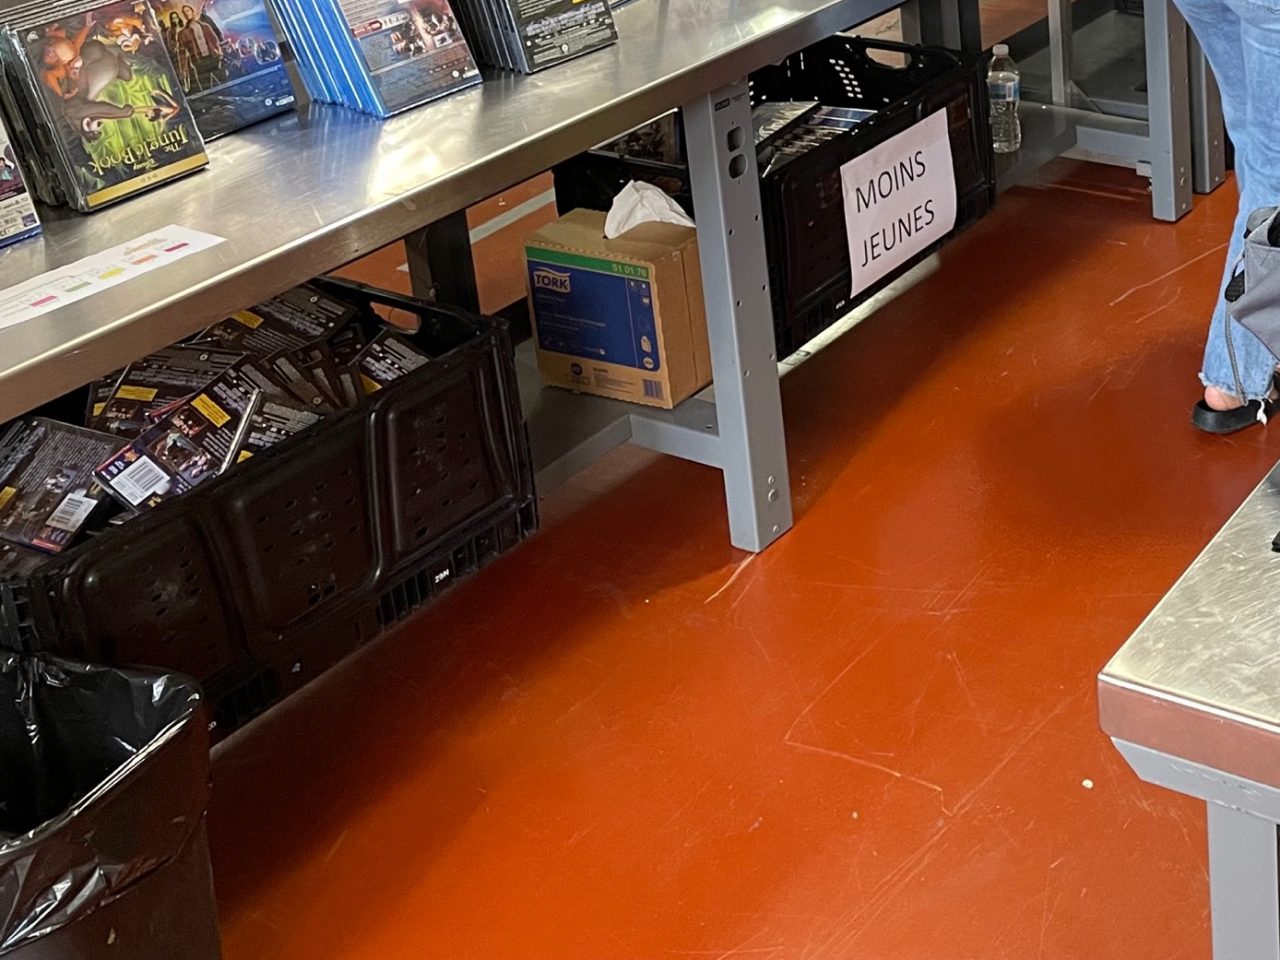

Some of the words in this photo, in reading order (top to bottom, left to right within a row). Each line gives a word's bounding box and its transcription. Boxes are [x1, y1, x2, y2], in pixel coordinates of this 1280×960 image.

[136, 123, 189, 158] Jungle
[164, 142, 182, 153] The
[88, 146, 135, 176] Book
[855, 150, 926, 214] MOINS
[861, 199, 935, 268] JEUNES
[535, 273, 568, 289] TORK
